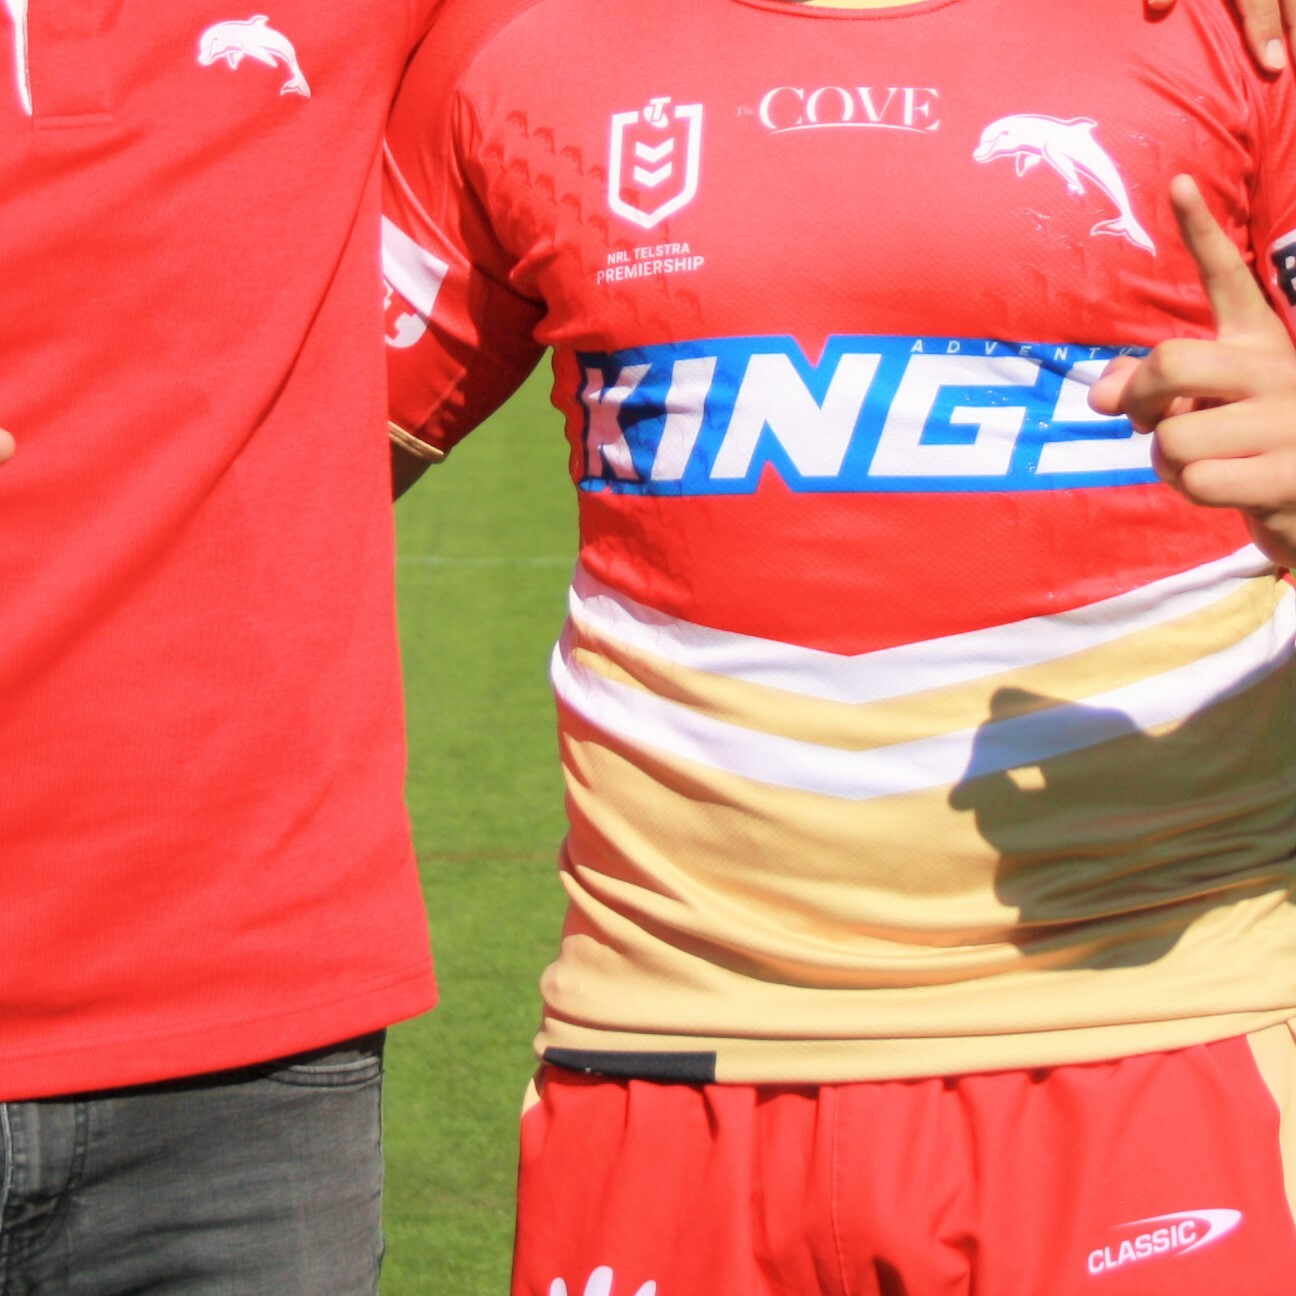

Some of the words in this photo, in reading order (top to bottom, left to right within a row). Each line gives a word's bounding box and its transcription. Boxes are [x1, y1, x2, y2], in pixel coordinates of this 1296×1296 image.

[759, 85, 941, 132] COVE
[597, 255, 704, 285] PREMIERSHIP
[607, 250, 630, 265] NRL
[633, 242, 690, 261] TELSTRA
[1088, 1220, 1197, 1274] CLASSIC
